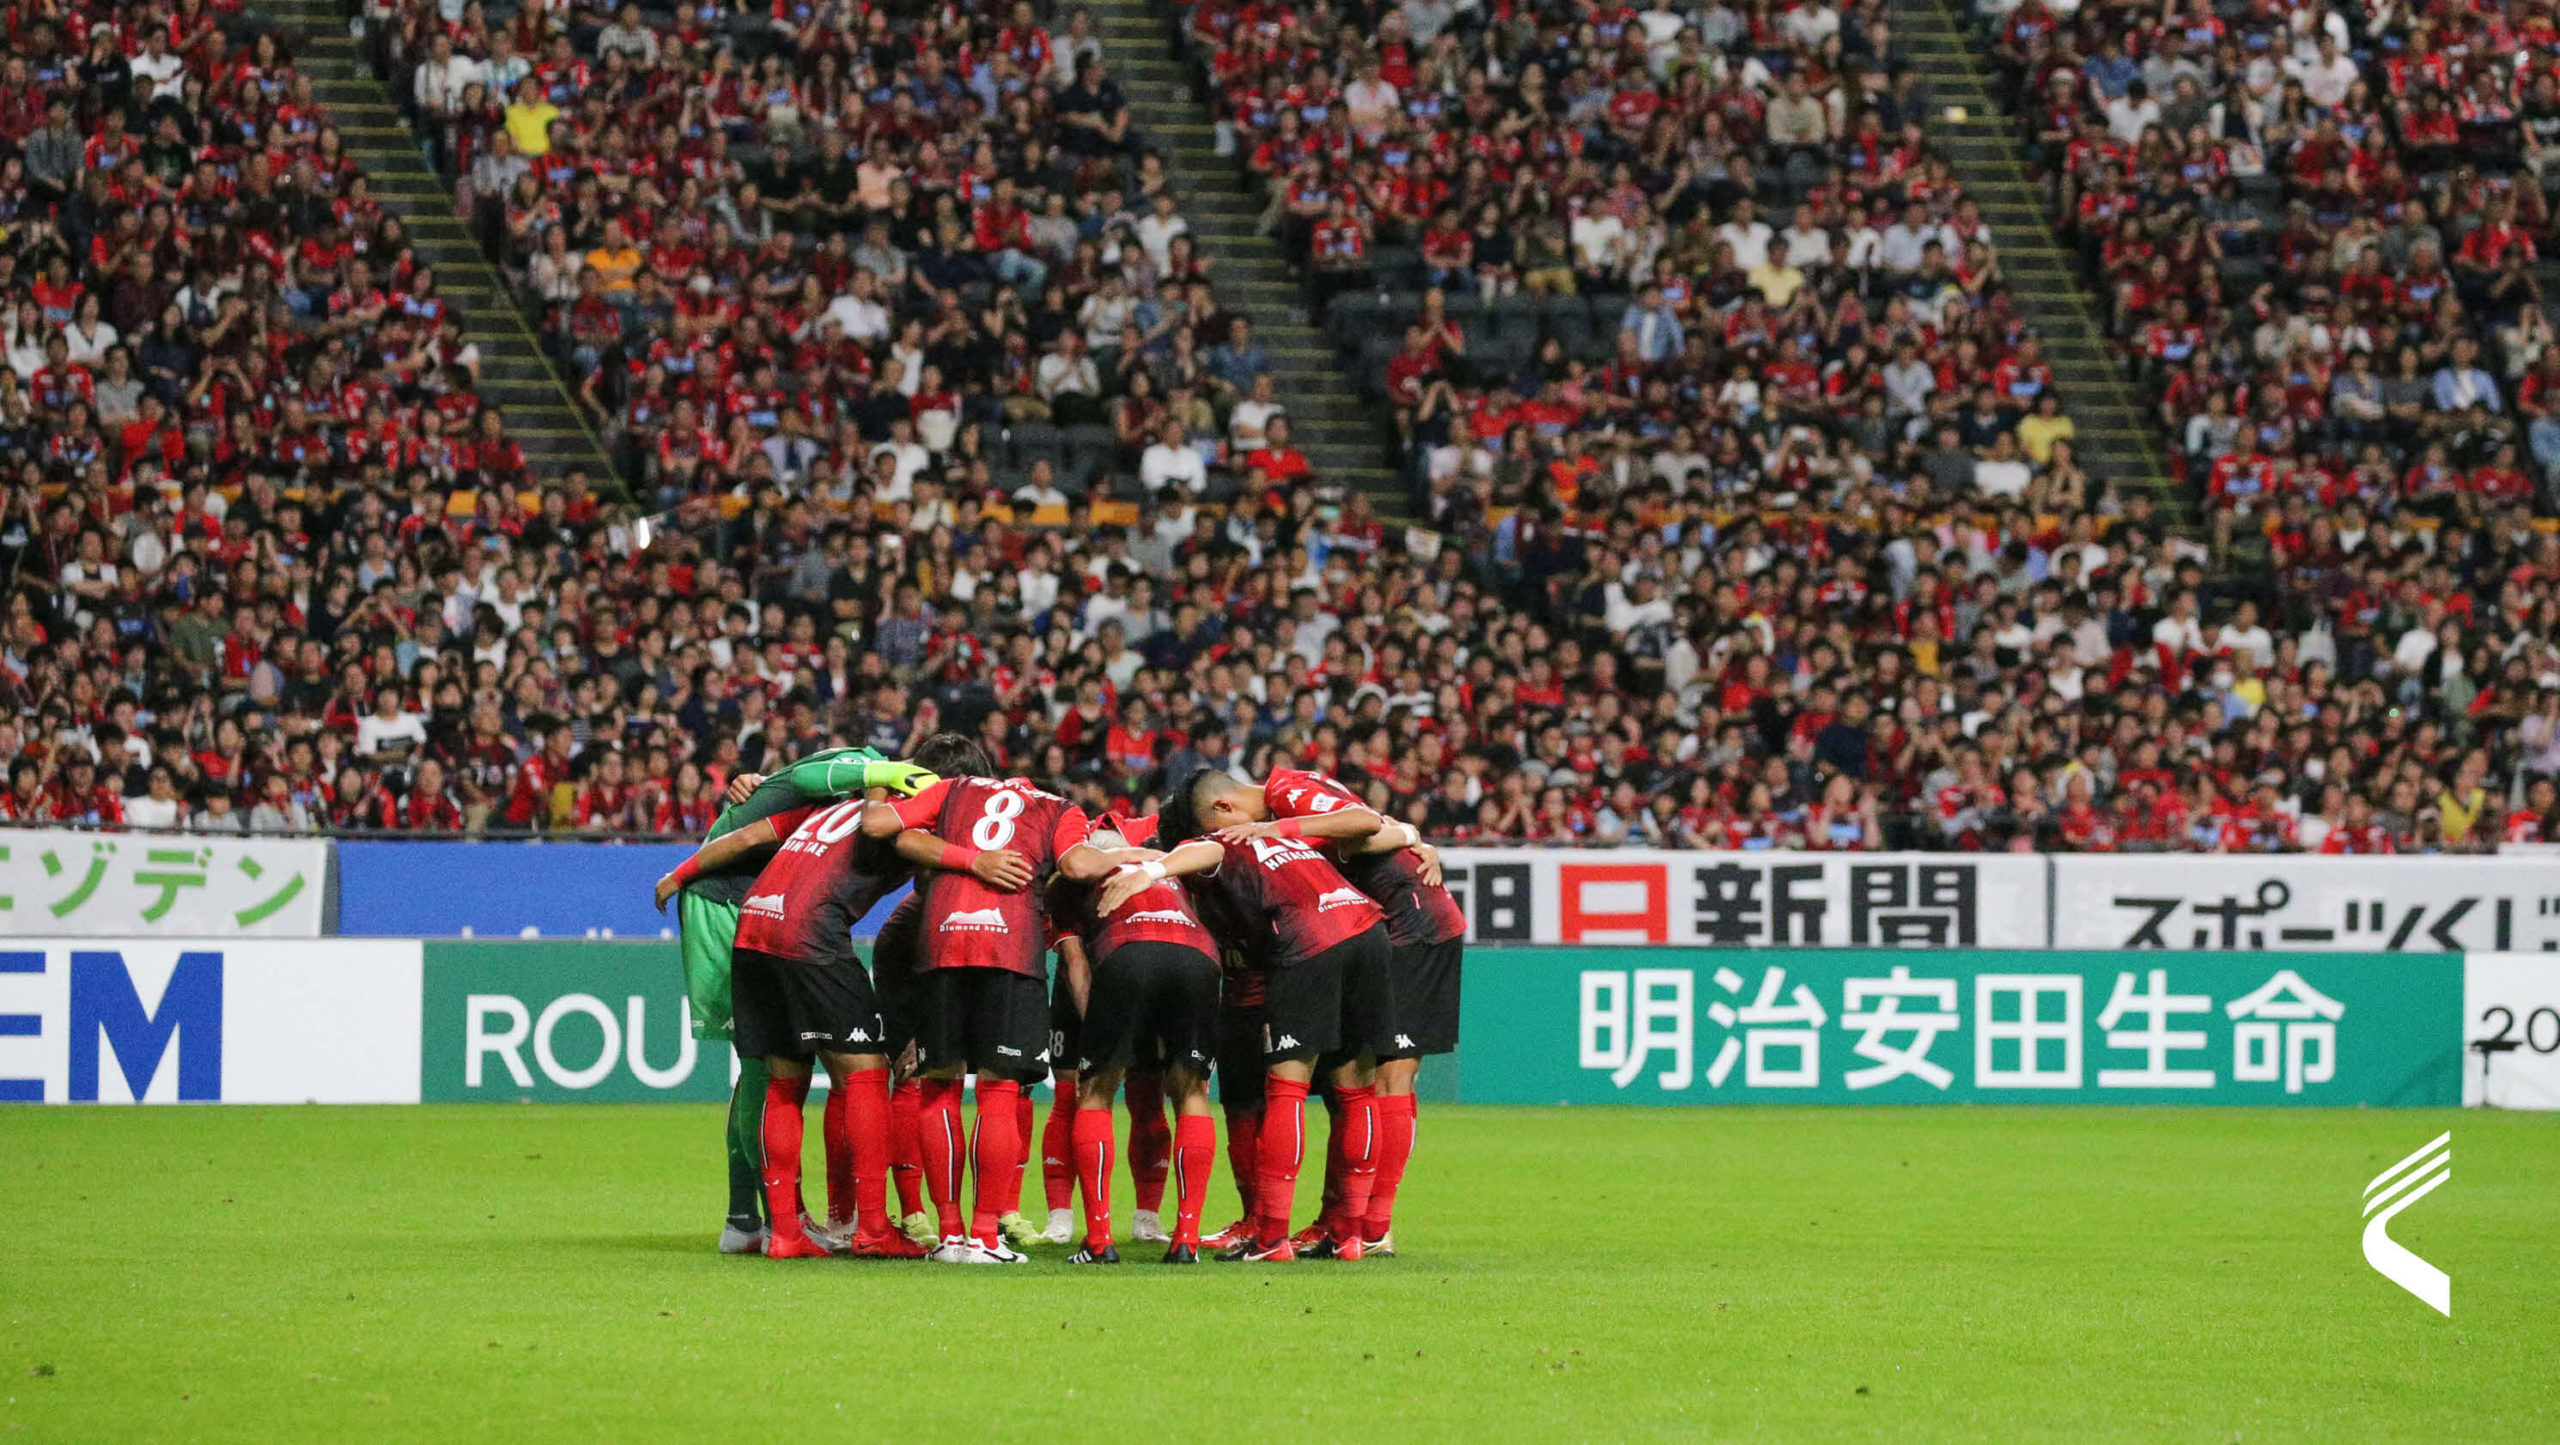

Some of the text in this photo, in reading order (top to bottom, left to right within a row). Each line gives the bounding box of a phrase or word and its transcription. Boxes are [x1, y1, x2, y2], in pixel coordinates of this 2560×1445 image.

[972, 789, 1025, 851] 8
[0, 840, 306, 928] ゾデン
[939, 924, 1009, 934] Diamond head
[465, 993, 741, 1089] ROU
[1579, 966, 2346, 1093] 明治安田生命
